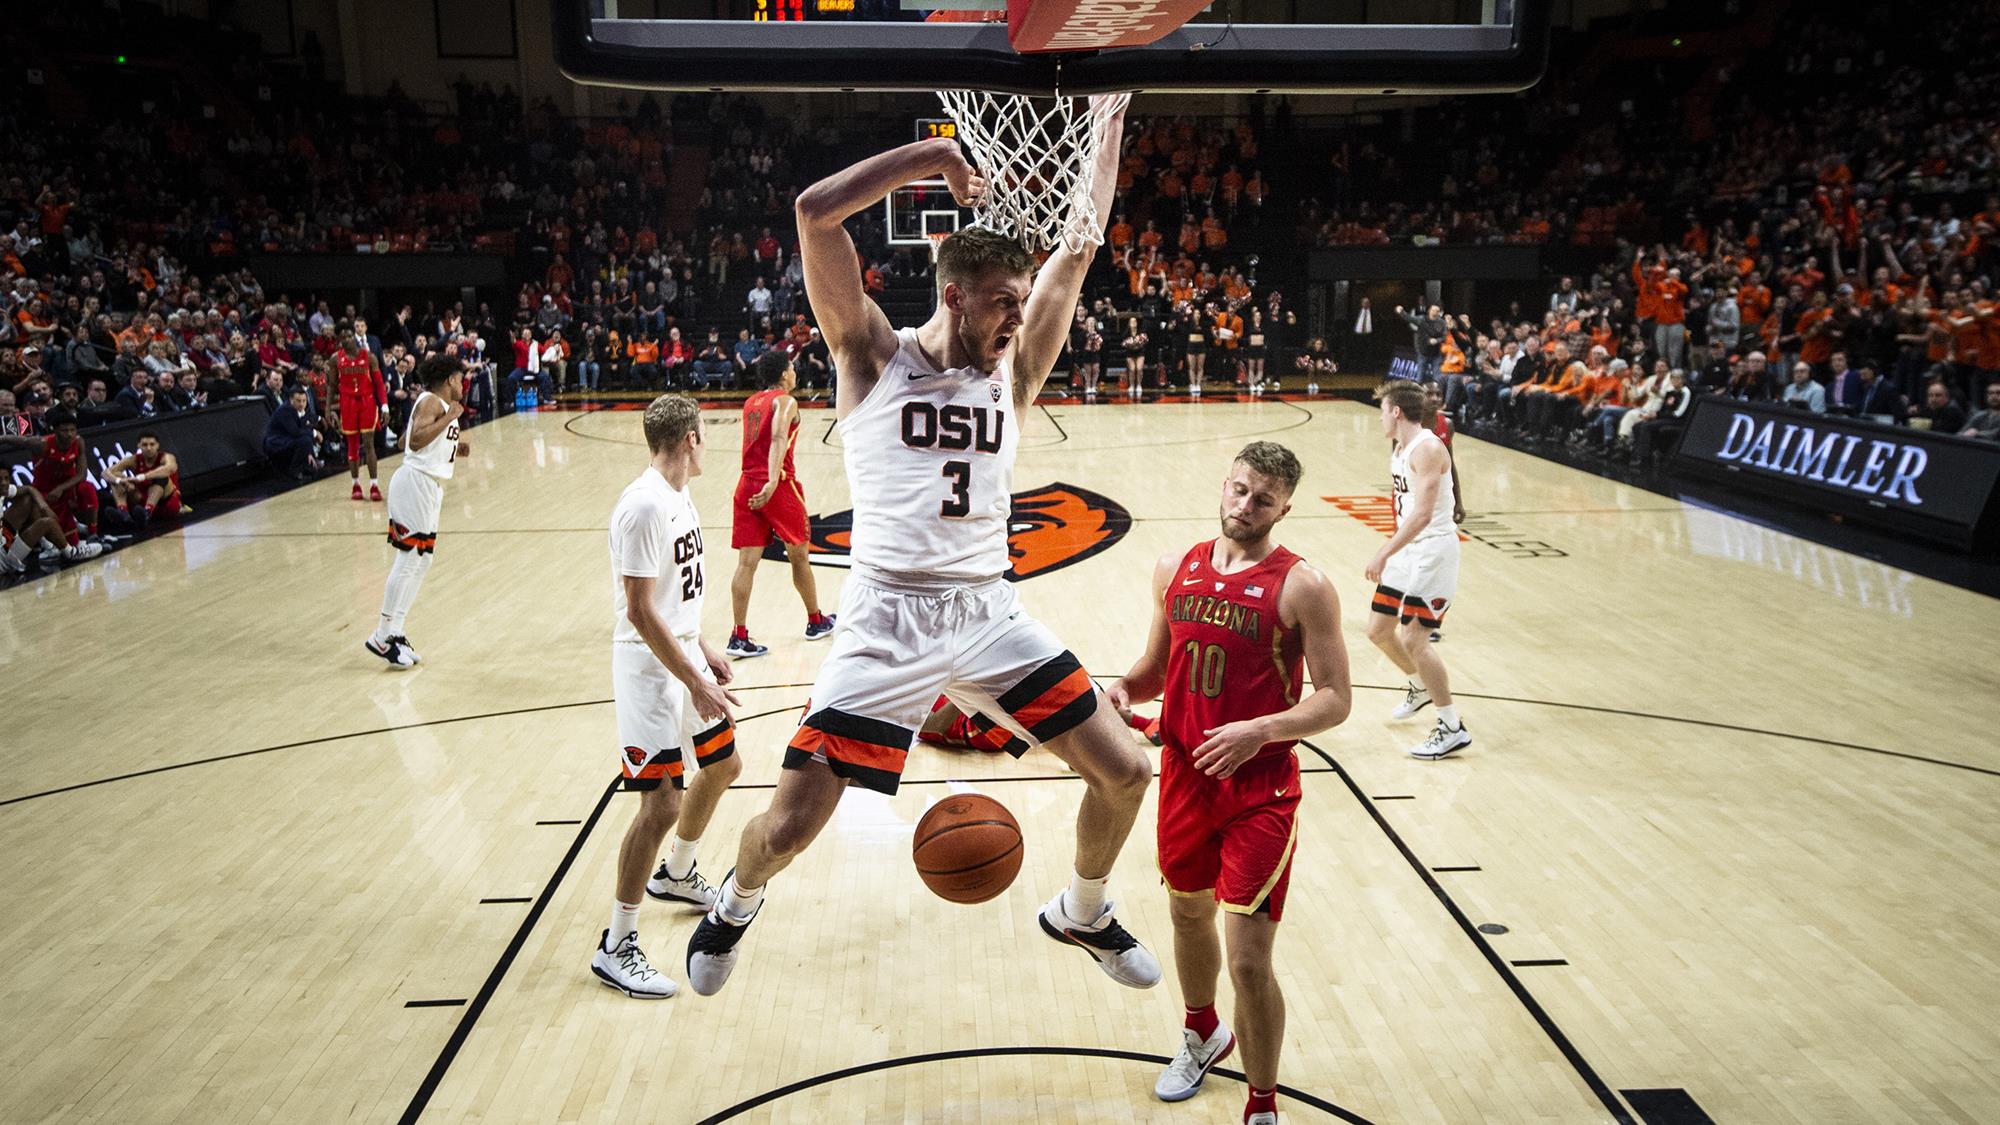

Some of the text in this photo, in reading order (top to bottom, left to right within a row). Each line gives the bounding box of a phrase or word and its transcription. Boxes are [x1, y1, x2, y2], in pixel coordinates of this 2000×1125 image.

[446, 425, 459, 441] OS
[901, 401, 1004, 454] OSU
[1717, 413, 1928, 504] DAIMLER
[940, 460, 971, 518] 3
[674, 527, 703, 565] OSU
[681, 562, 703, 602] 24
[1171, 594, 1261, 641] ARIZONA
[1186, 640, 1226, 698] 10
